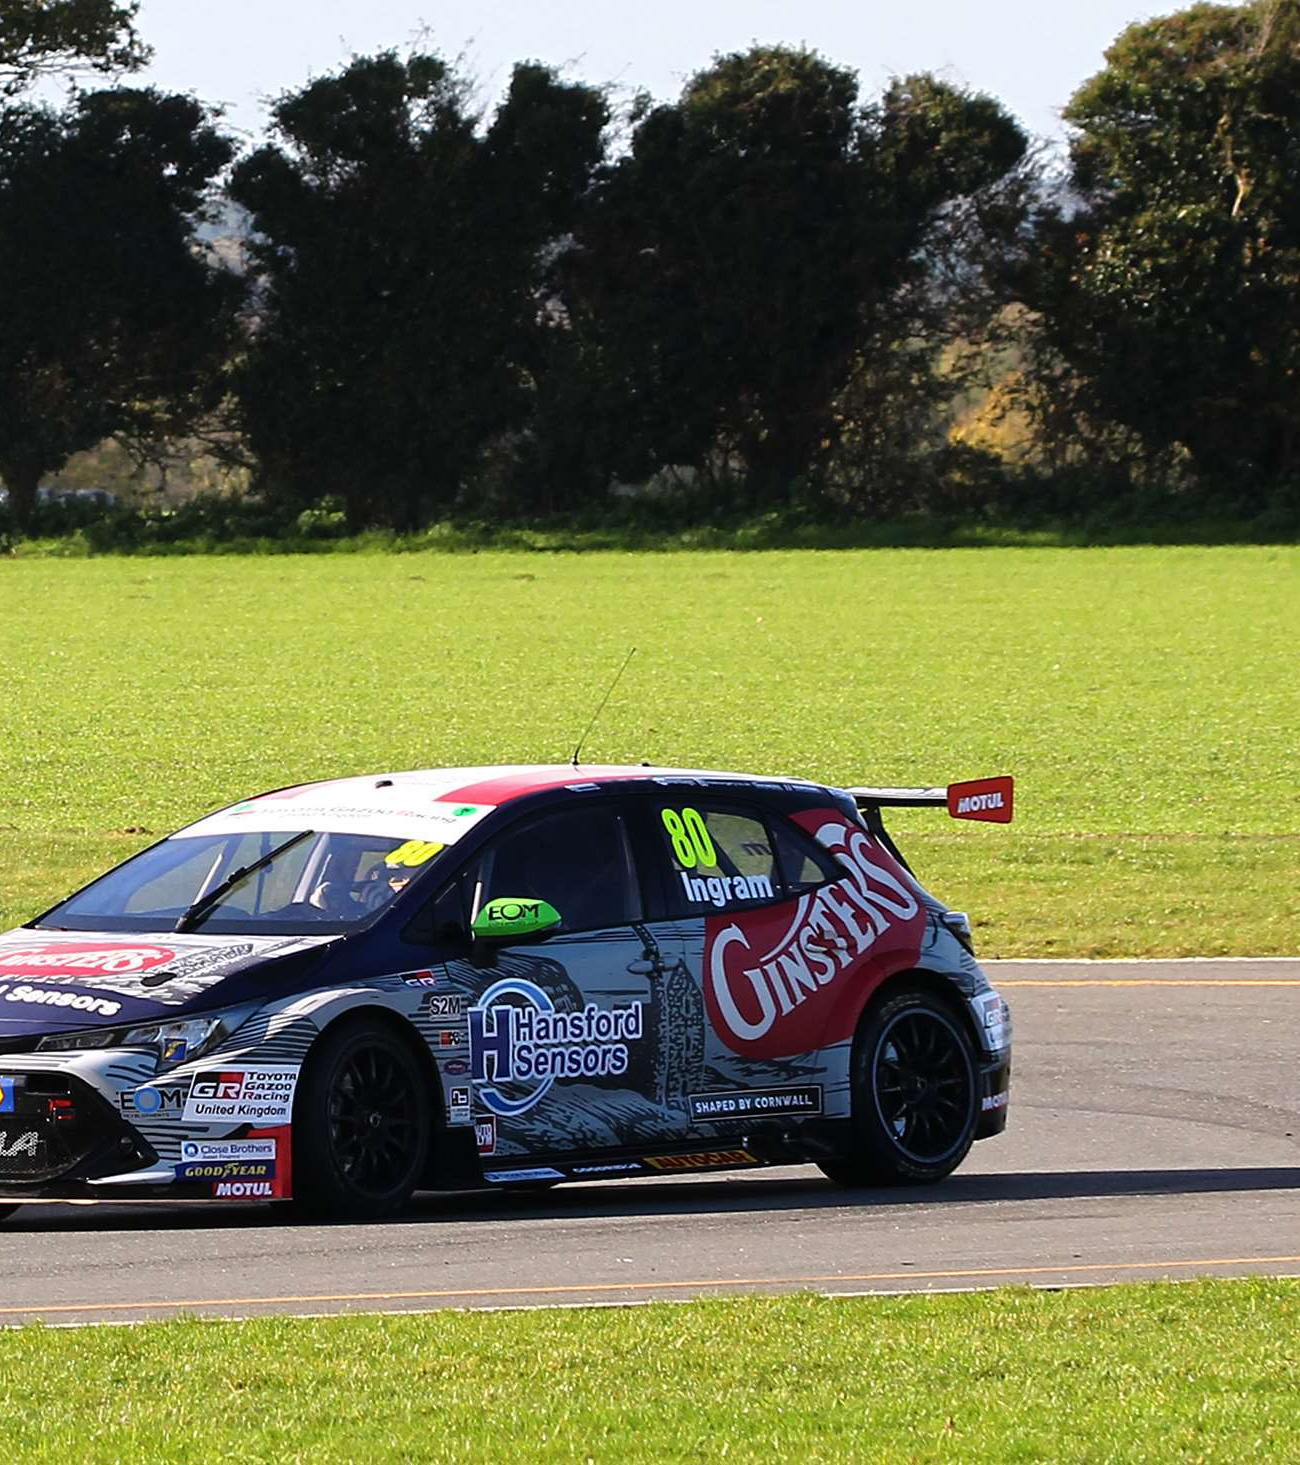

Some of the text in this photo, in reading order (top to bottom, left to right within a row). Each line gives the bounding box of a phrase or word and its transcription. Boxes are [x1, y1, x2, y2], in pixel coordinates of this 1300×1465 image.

[957, 791, 1005, 813] MOTUL
[661, 807, 717, 868] 80
[385, 840, 444, 867] 80
[680, 871, 775, 907] Ingram
[487, 903, 540, 921] EOM
[5, 985, 122, 1016] Sensors
[431, 996, 460, 1016] S2M
[515, 1002, 641, 1043] Hansford
[515, 1044, 628, 1078] Sensors
[244, 1081, 293, 1092] GAZOO
[246, 1072, 297, 1082] TOYOTA
[192, 1081, 241, 1099] GR
[242, 1091, 290, 1104] Racing
[195, 1104, 287, 1118] United Kingdom
[695, 1094, 814, 1113] SHAPED BY CORNWALL
[200, 1144, 273, 1154] Close Brothers
[216, 1183, 273, 1196] MOTUL
